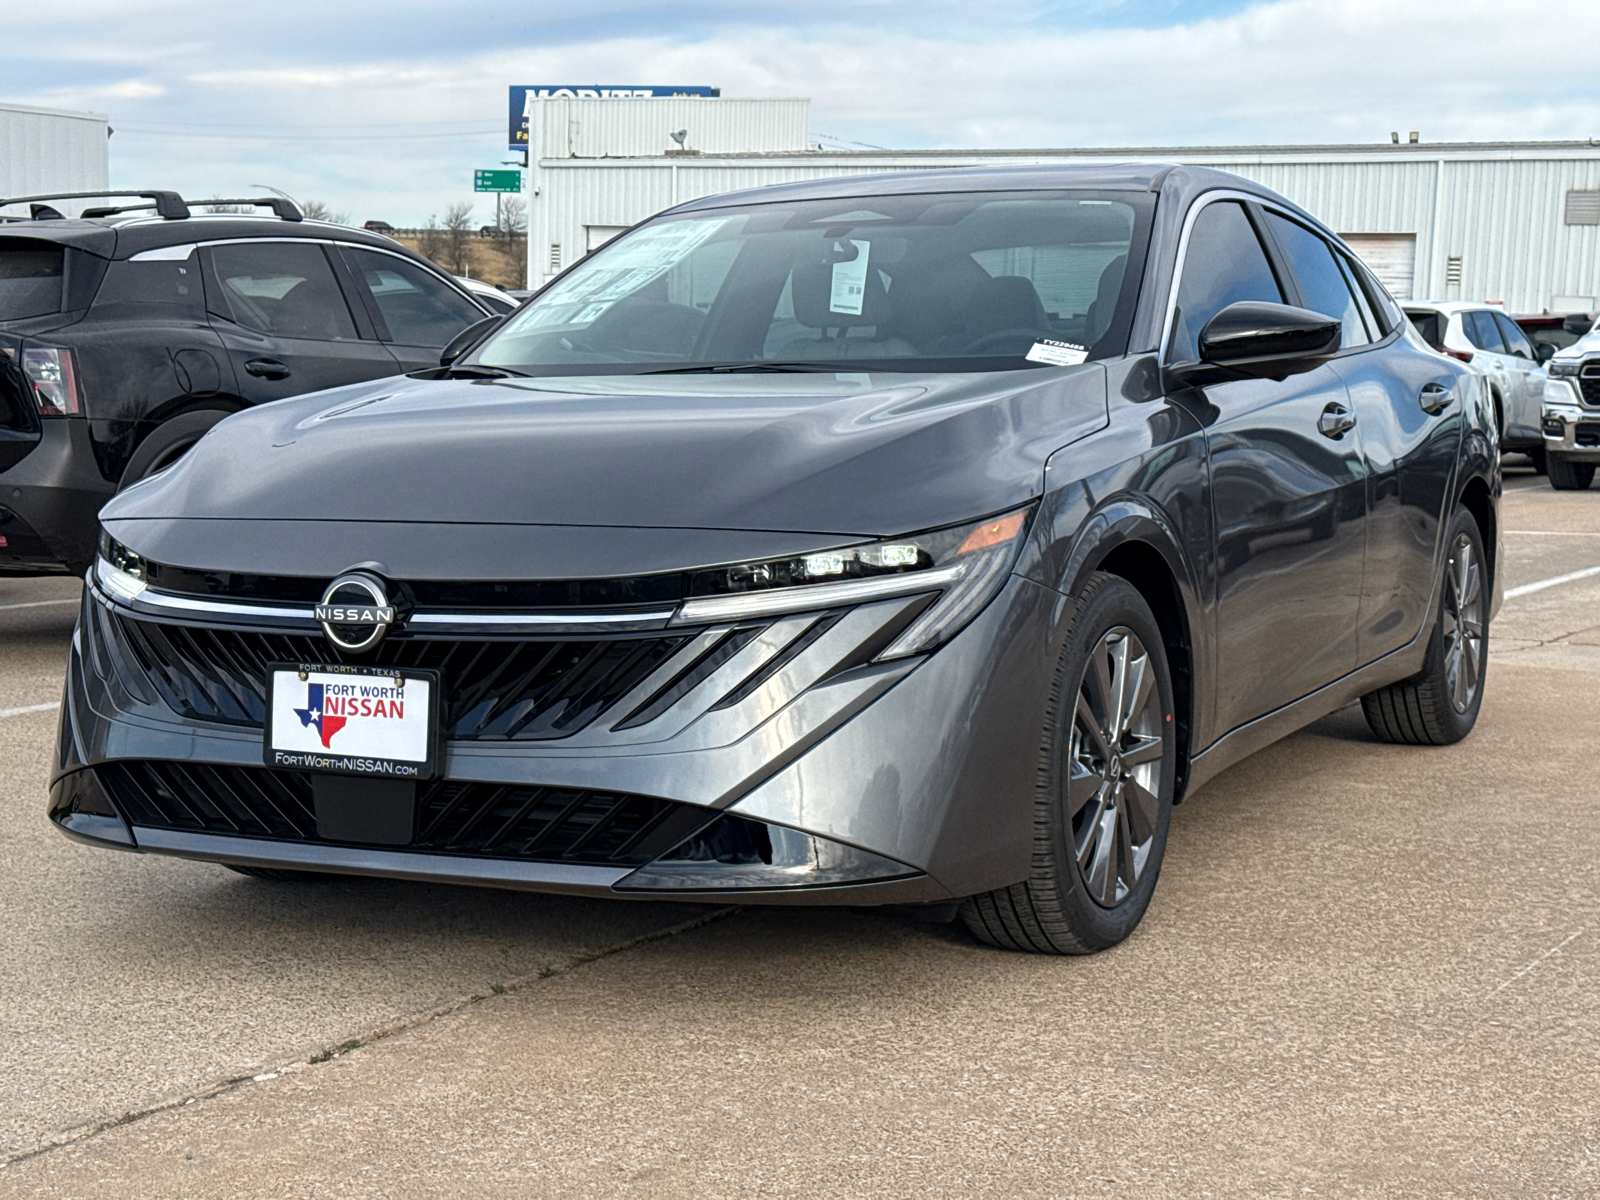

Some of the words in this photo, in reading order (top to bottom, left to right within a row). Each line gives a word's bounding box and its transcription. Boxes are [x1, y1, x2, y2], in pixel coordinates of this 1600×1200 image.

[316, 608, 390, 620] NISSAN
[299, 664, 322, 672] FORT
[326, 665, 358, 674] WORTH
[371, 668, 401, 678] TEXAS
[325, 684, 357, 696] FORT
[360, 686, 404, 699] WORTH
[325, 696, 404, 719] NISSAN
